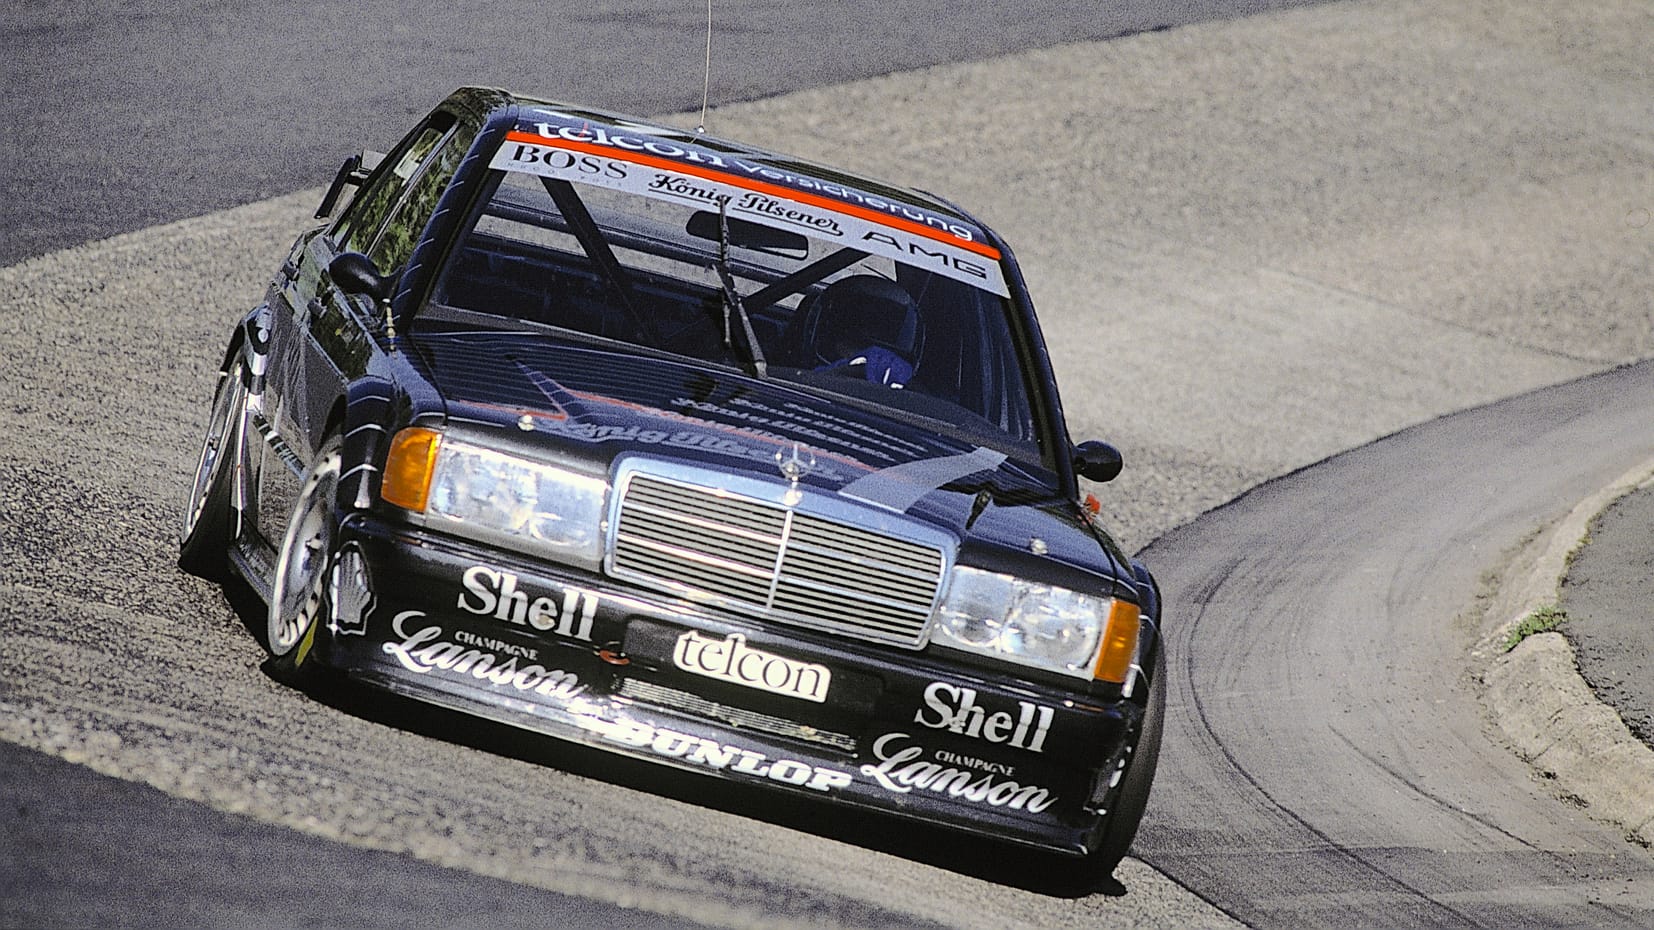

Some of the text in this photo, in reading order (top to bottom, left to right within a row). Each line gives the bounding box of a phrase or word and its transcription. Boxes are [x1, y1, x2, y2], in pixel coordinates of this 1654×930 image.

[512, 144, 628, 180] BOSS
[533, 121, 729, 169] telcon
[648, 173, 844, 237] König Pilsener
[862, 230, 988, 280] AMG
[457, 565, 600, 642] Shell
[382, 610, 588, 700] Lanson
[454, 630, 540, 661] CHAMPAGNE
[678, 636, 822, 698] telcon
[913, 681, 1055, 753] Shell
[606, 717, 853, 792] DUNLOP
[860, 732, 1059, 814] Lanson
[934, 750, 1017, 777] CHAMPAGNE
